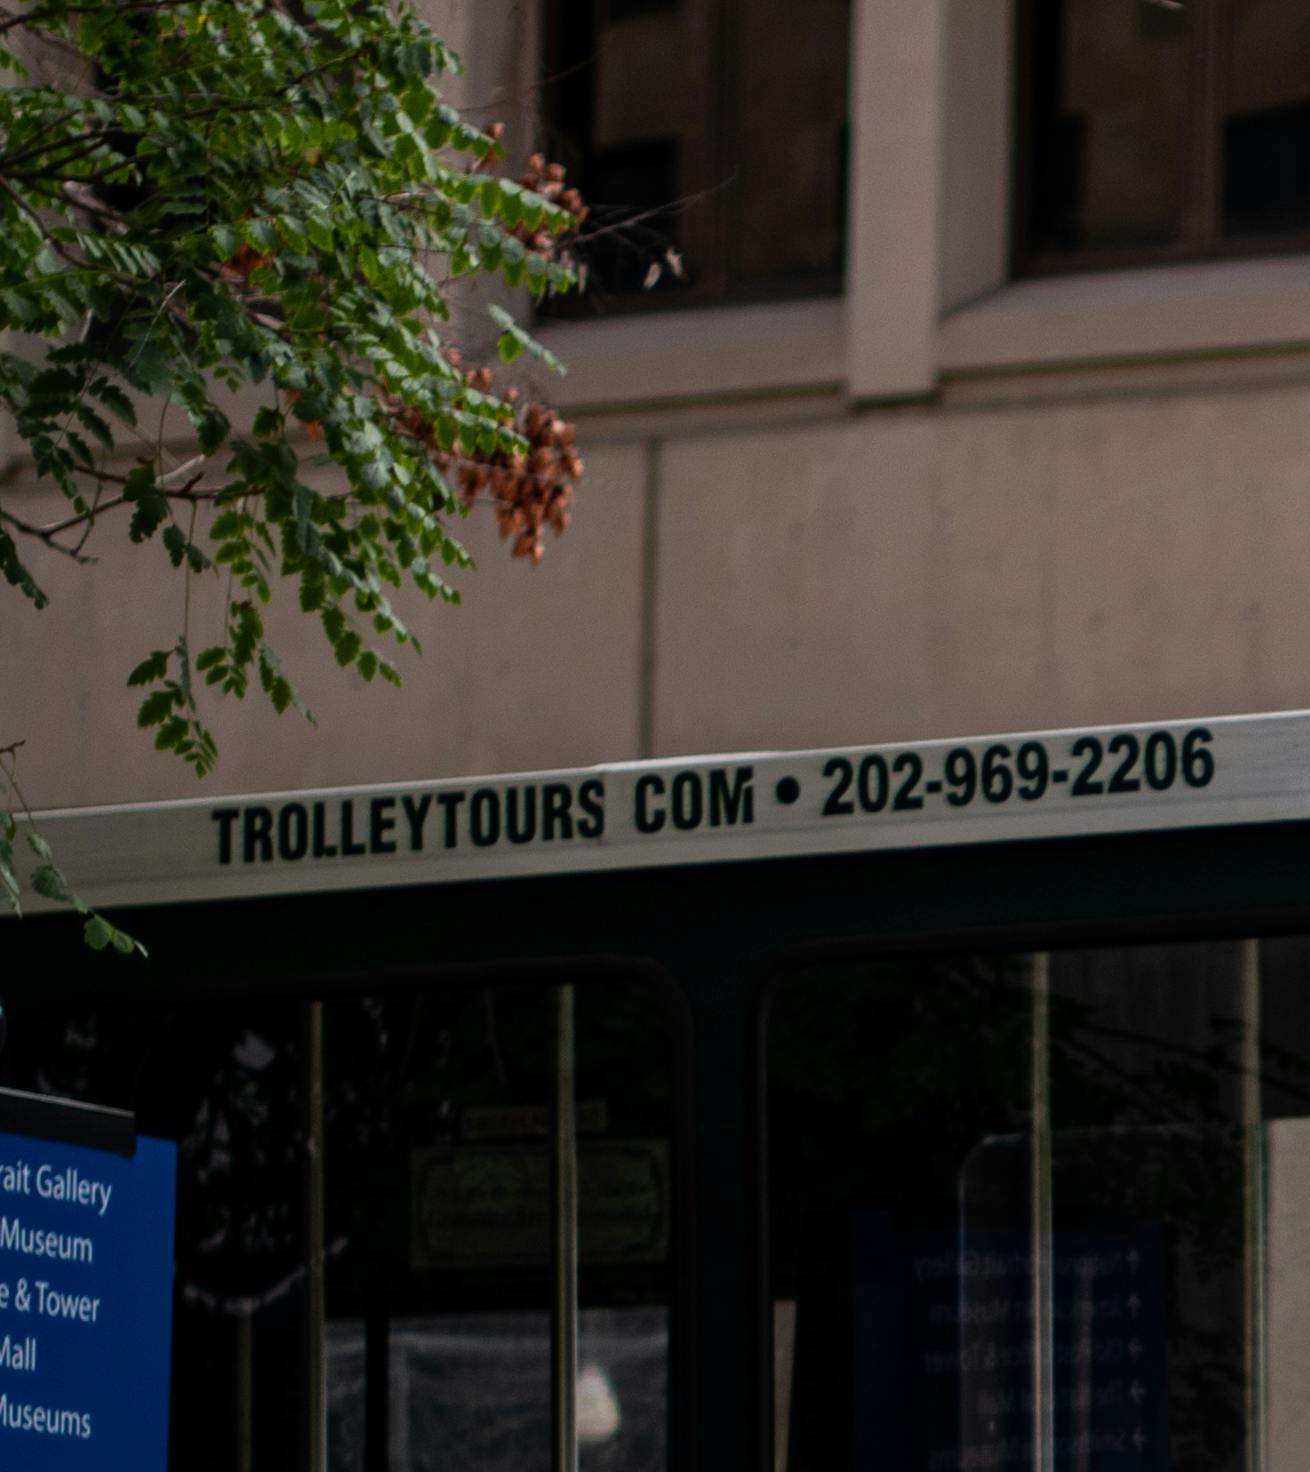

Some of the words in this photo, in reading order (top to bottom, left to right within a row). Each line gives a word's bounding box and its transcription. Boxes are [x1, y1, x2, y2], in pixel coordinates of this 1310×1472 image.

[211, 778, 605, 866] TROLLEYTOURS
[633, 765, 755, 834] COM
[821, 727, 1215, 818] 202-969-2206
[36, 1163, 113, 1217] Gallery
[0, 1215, 94, 1264] Museum
[14, 1276, 32, 1313] &
[34, 1279, 101, 1324] Tower
